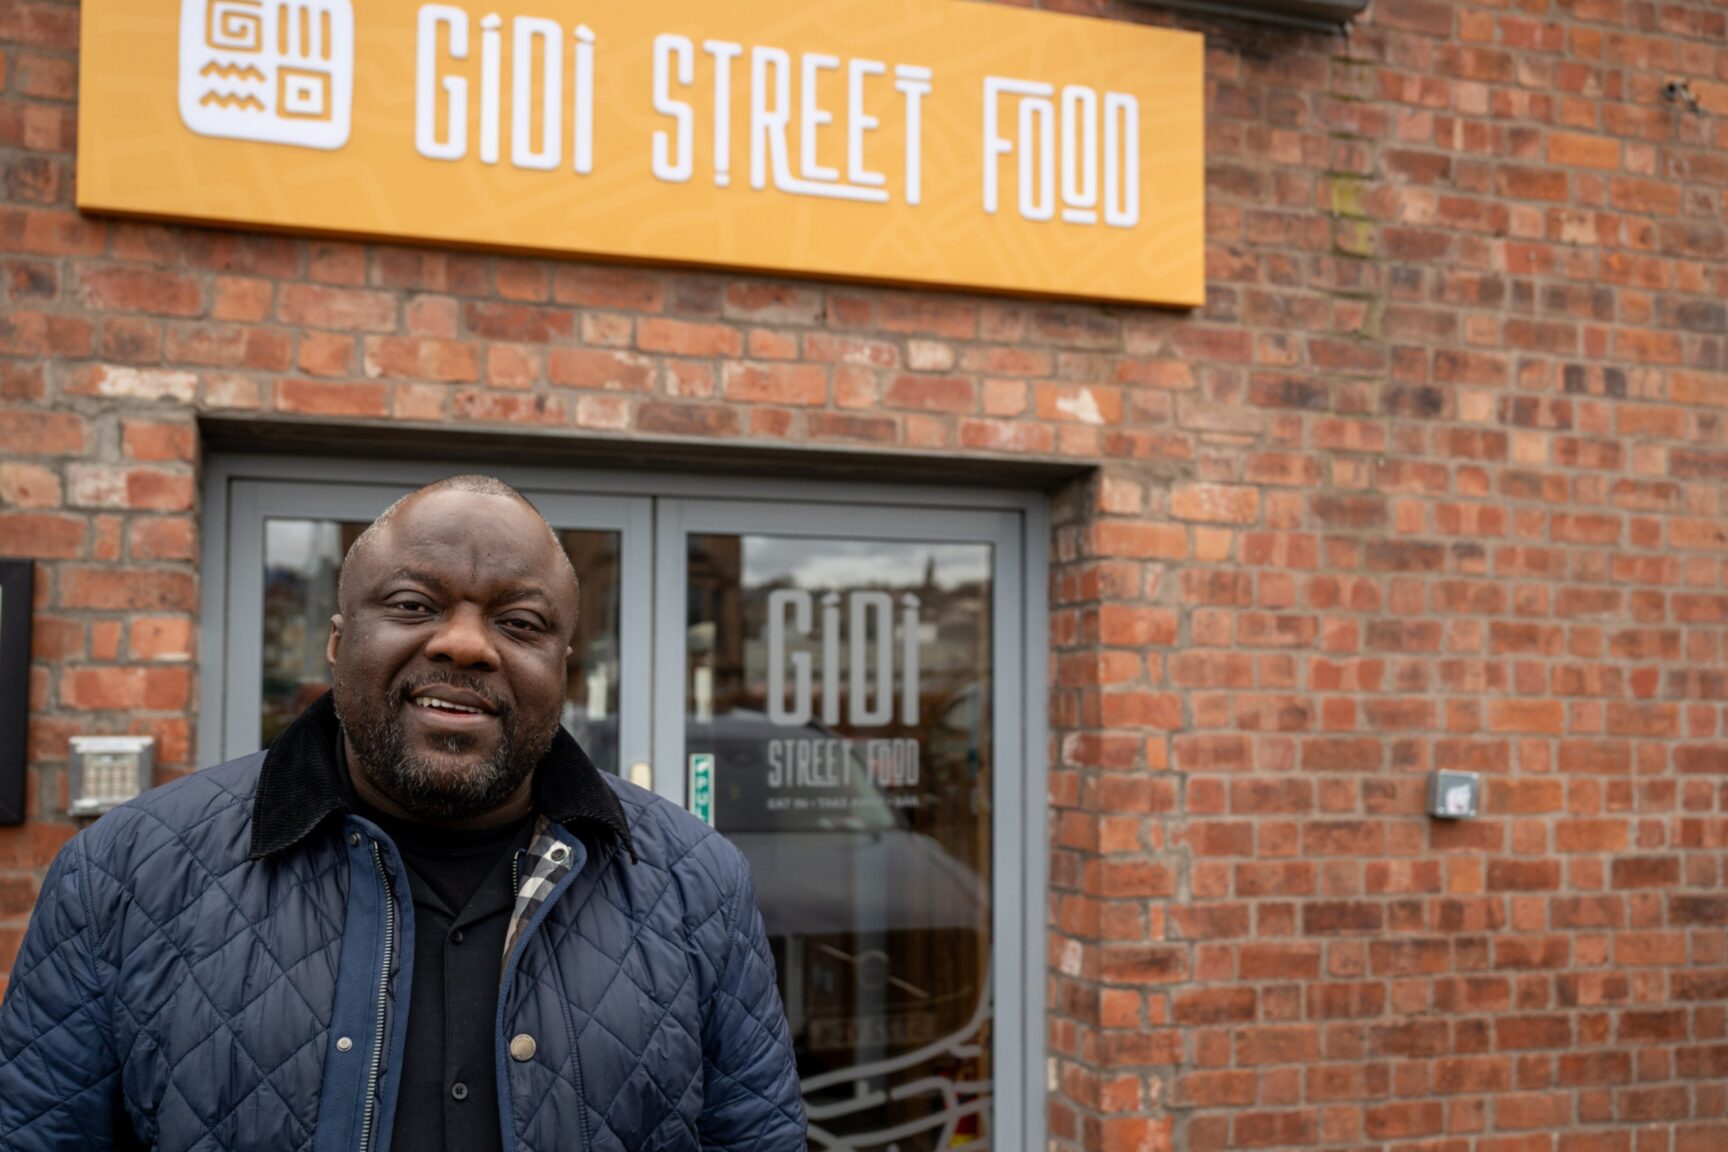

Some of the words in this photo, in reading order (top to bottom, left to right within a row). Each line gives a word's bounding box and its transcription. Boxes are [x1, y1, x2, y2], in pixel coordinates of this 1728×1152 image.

[652, 33, 932, 206] STREET
[983, 76, 1140, 228] FOOD
[767, 738, 852, 788] STREET
[866, 738, 920, 787] FOOD
